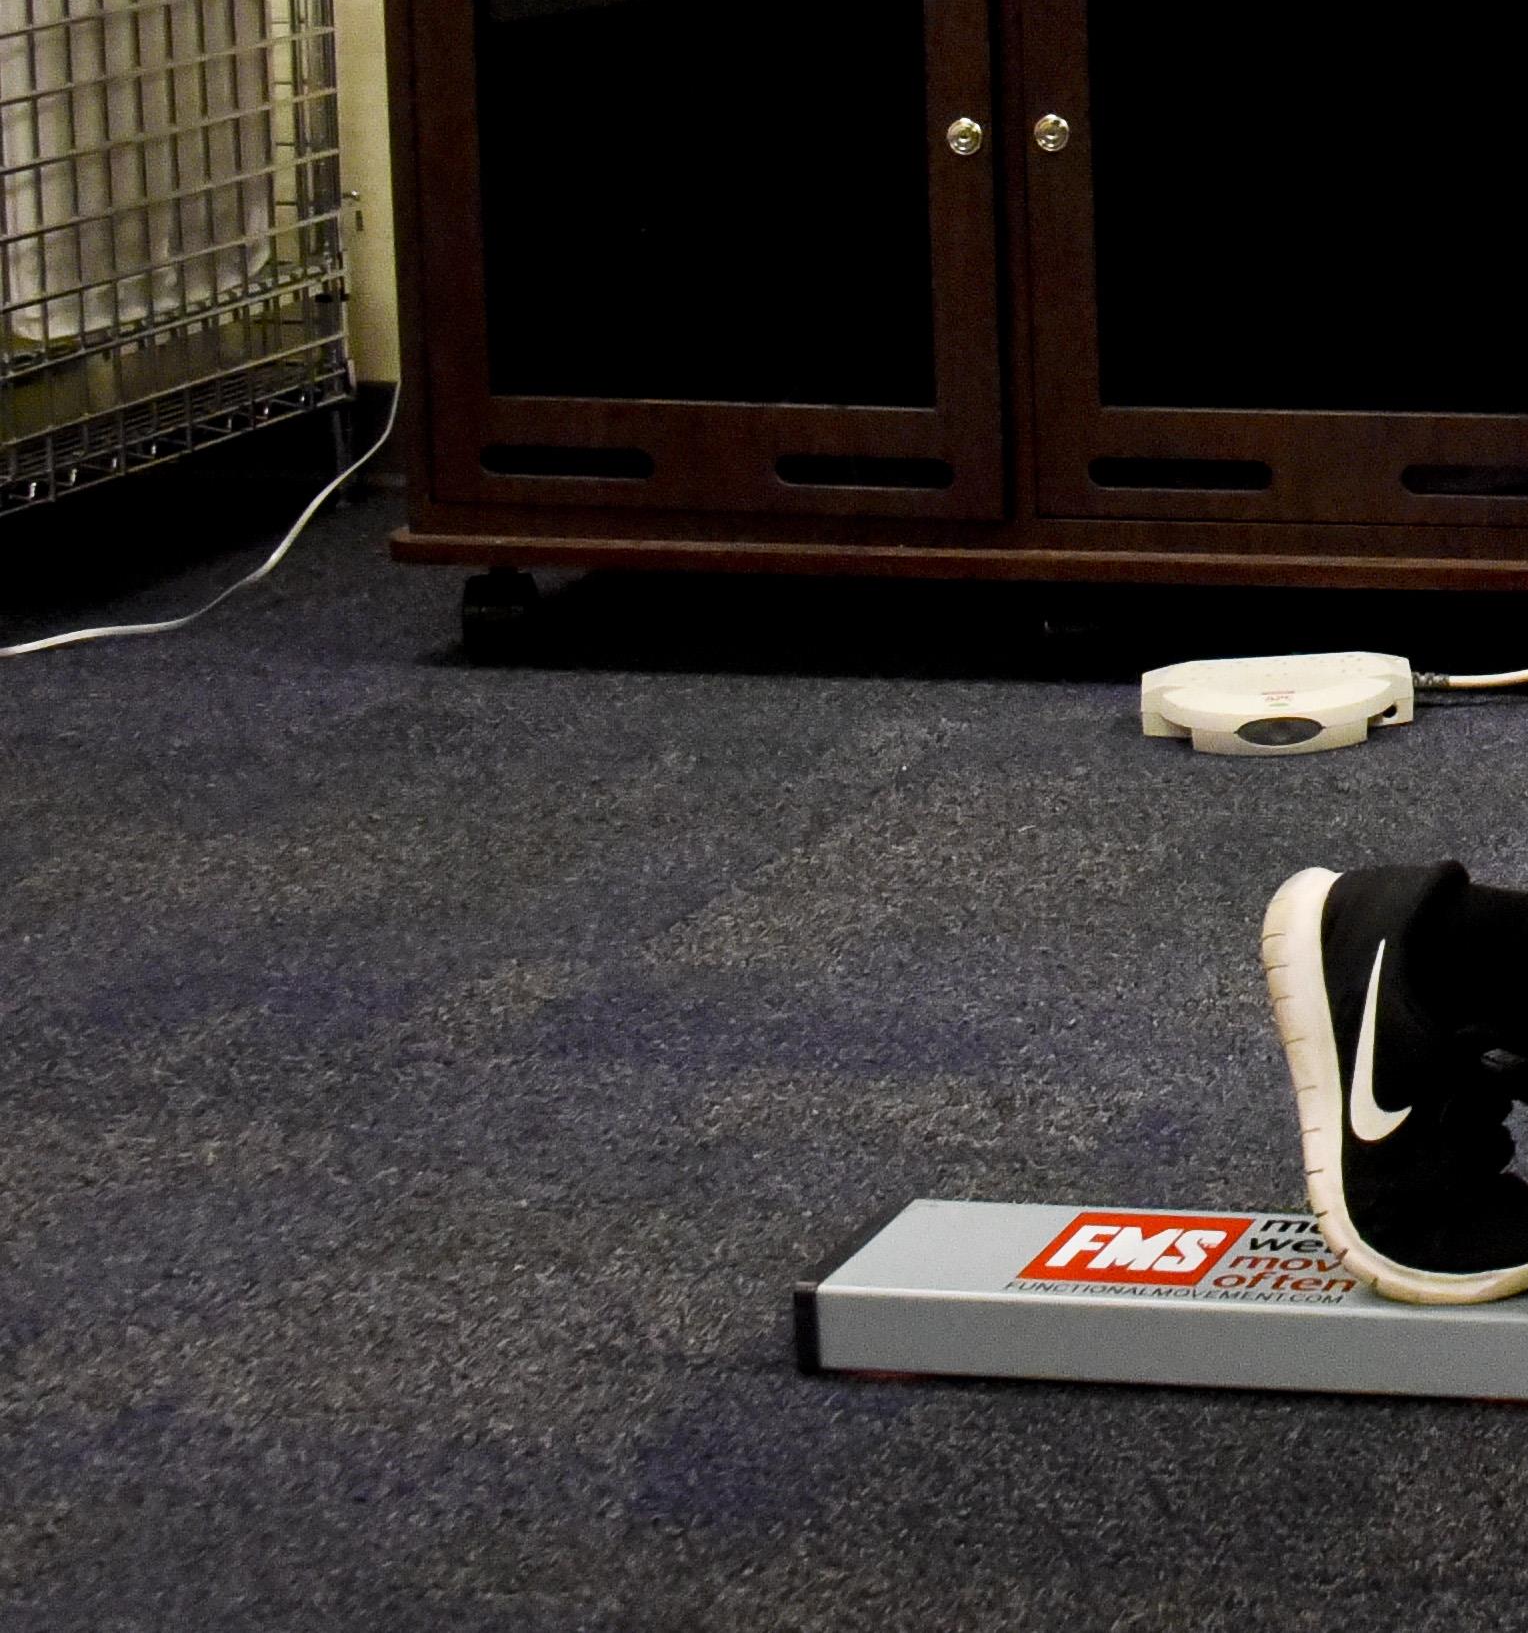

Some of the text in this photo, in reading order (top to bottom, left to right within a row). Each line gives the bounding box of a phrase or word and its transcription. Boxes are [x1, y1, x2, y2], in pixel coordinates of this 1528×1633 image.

[1044, 1224, 1228, 1273] FMS
[1228, 1255, 1344, 1273] mov
[1003, 1280, 1344, 1304] FUNCTIONALMOVEMENT.COM
[1212, 1271, 1359, 1294] often
